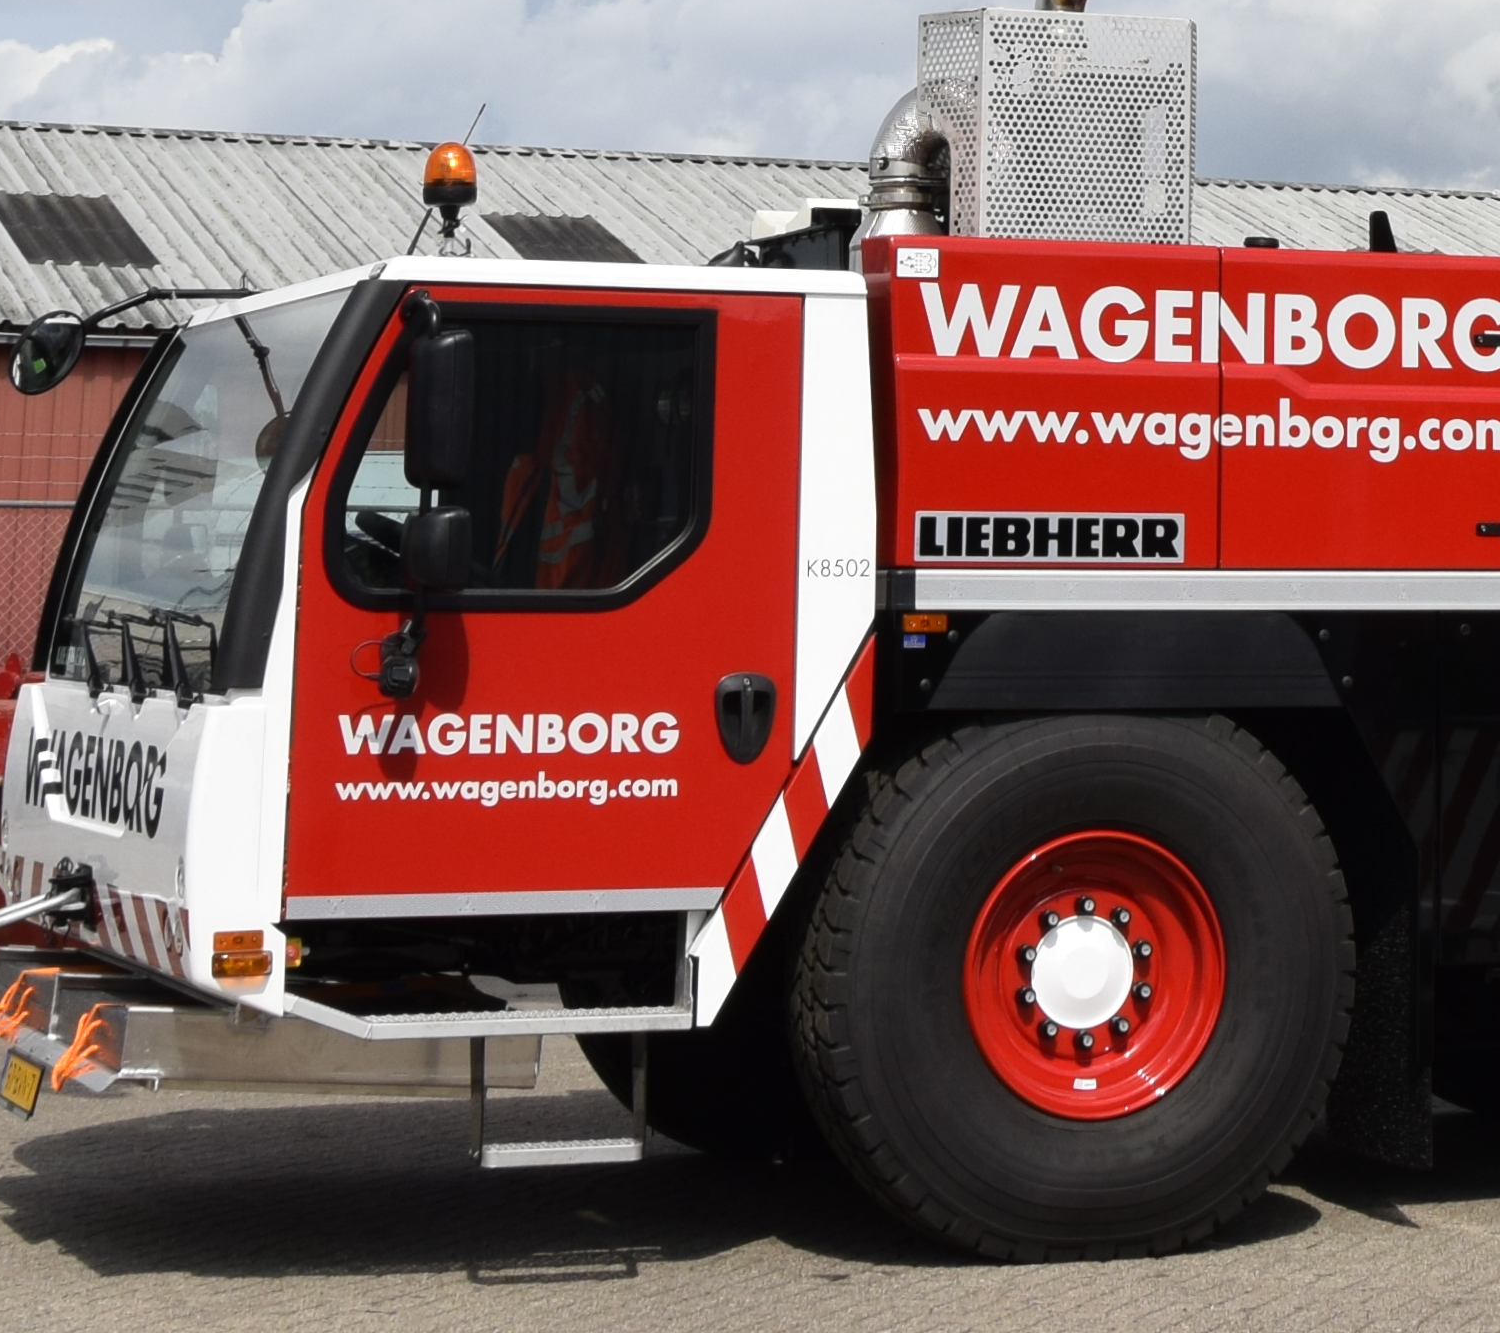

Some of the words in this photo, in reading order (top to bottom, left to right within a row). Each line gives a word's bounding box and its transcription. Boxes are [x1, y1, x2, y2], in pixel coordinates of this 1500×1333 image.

[918, 515, 1181, 559] LIEBHERR
[806, 558, 871, 579] K8502
[338, 710, 680, 756] WAGENBORG
[25, 726, 167, 839] WAGENBORG
[335, 771, 680, 806] www.wagenborg.com
